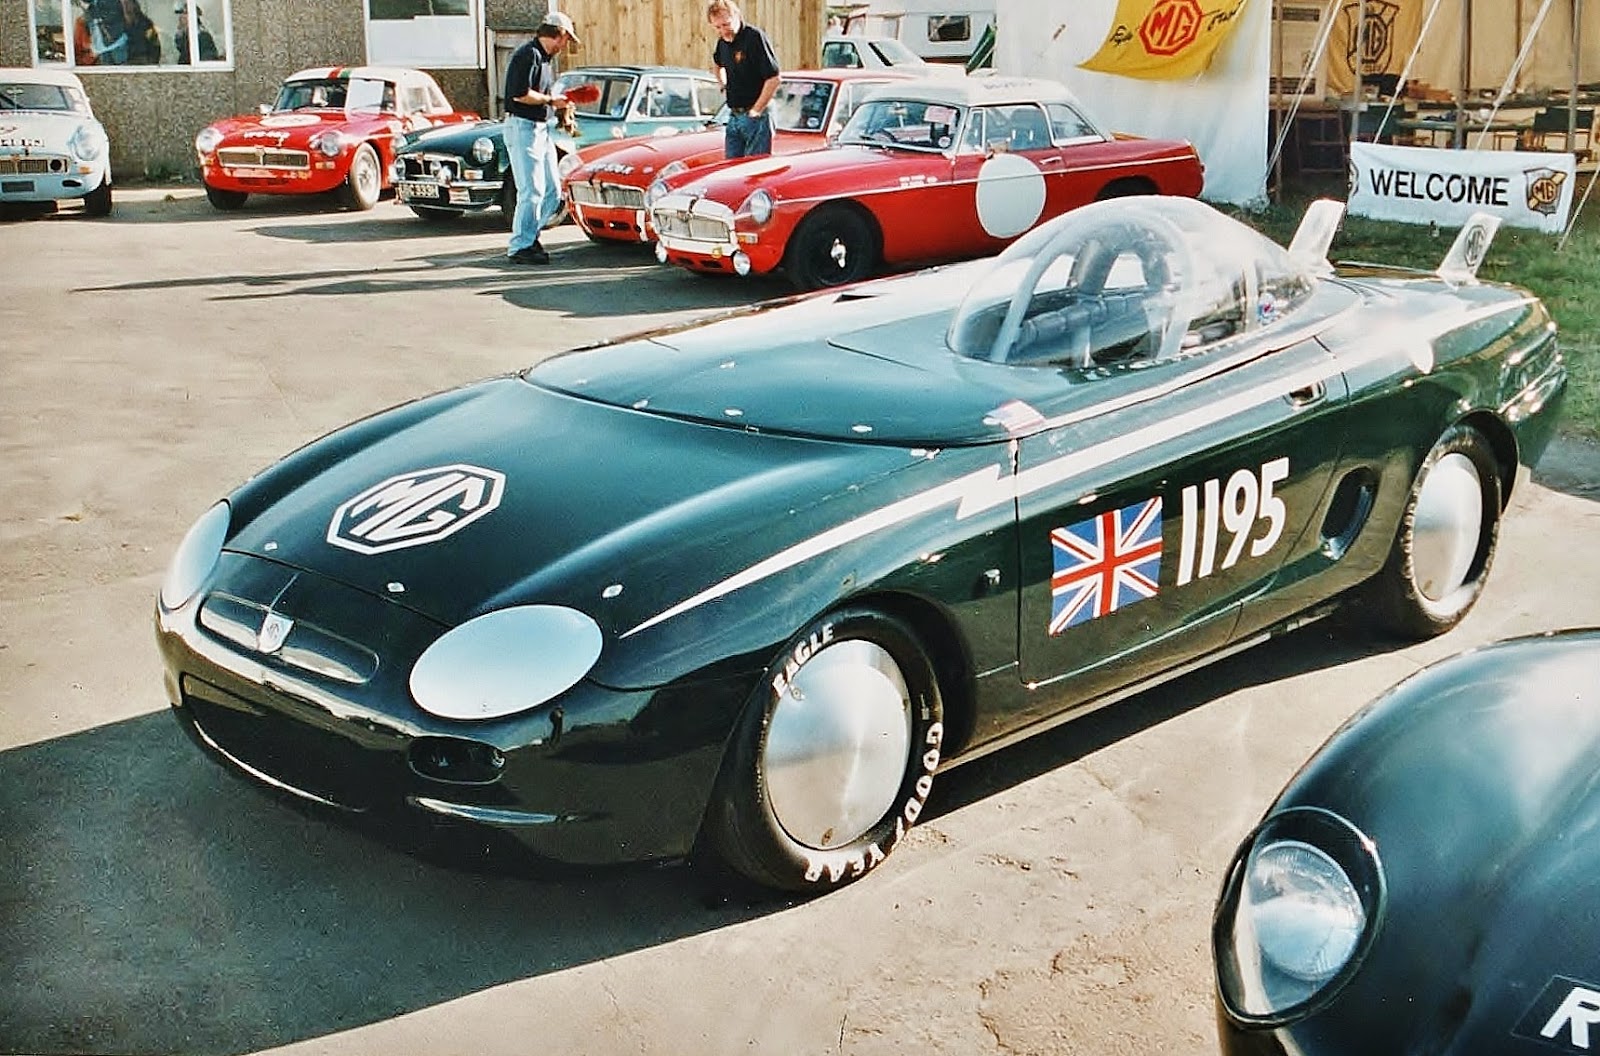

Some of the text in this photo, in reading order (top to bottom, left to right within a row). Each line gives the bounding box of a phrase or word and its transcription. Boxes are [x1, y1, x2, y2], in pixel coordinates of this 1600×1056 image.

[1149, 3, 1196, 49] MG
[1370, 168, 1509, 207] WELCOME
[349, 470, 487, 543] MG
[1176, 456, 1290, 587] 1195
[771, 622, 835, 699] EAGLE
[804, 721, 944, 883] GOODYEAR
[1539, 986, 1600, 1050] R
